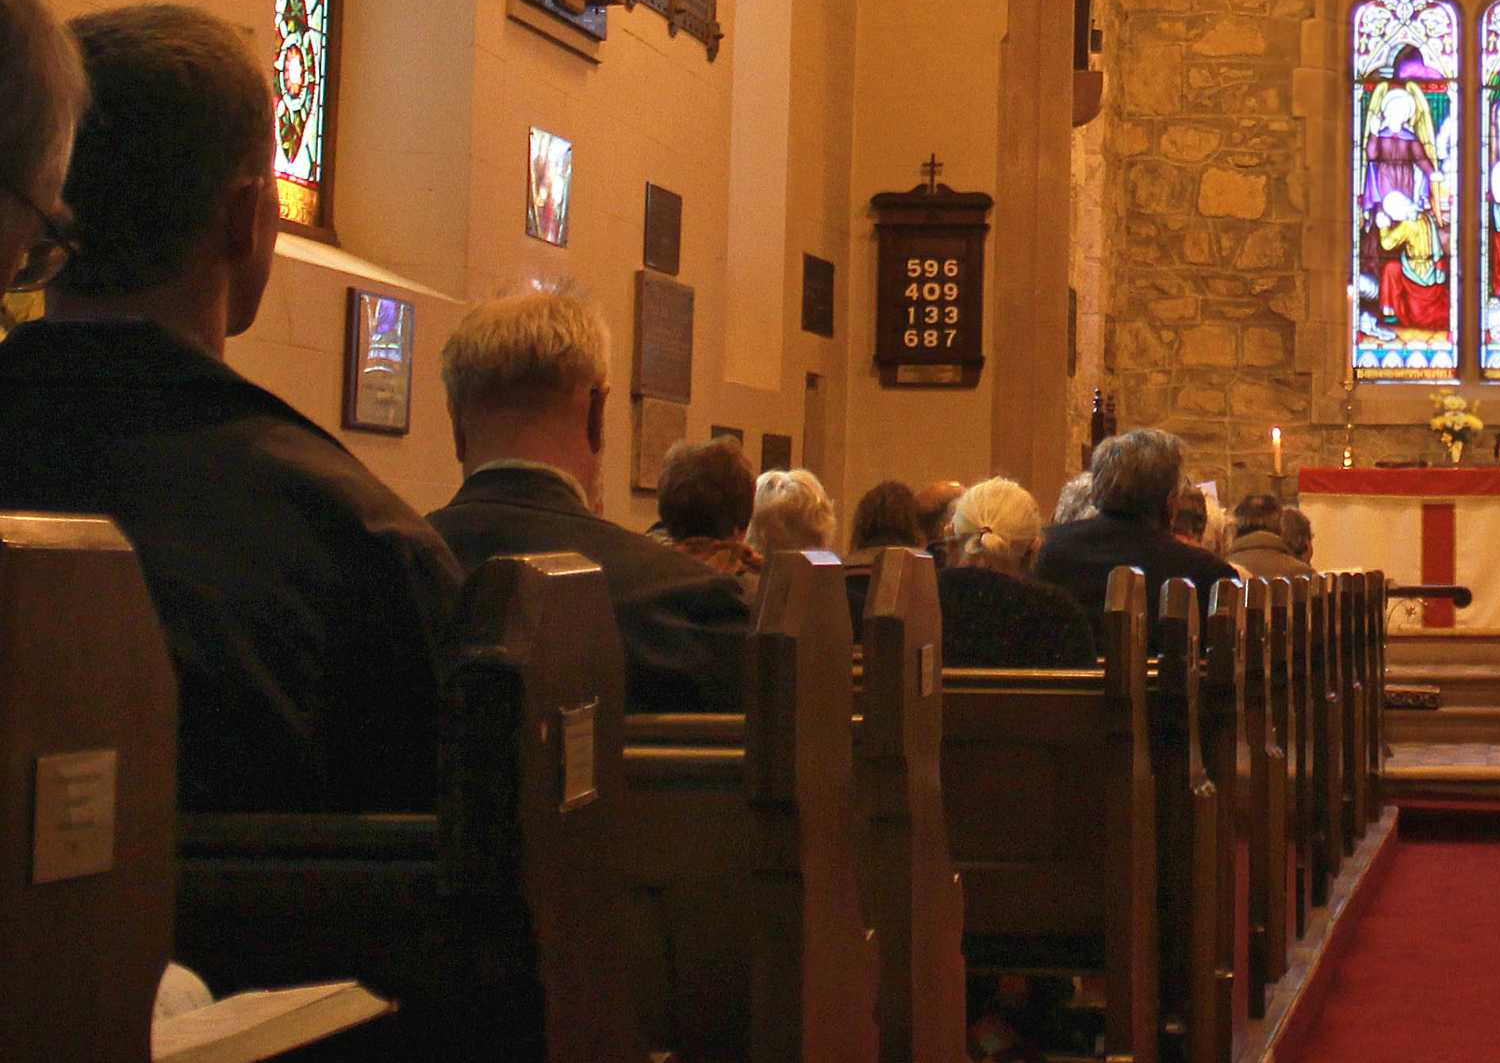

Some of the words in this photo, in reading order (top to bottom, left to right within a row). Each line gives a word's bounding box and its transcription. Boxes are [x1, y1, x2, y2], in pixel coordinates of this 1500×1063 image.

[907, 259, 958, 278] 596
[905, 282, 958, 301] 409
[907, 306, 958, 324] 133
[904, 329, 957, 348] 687
